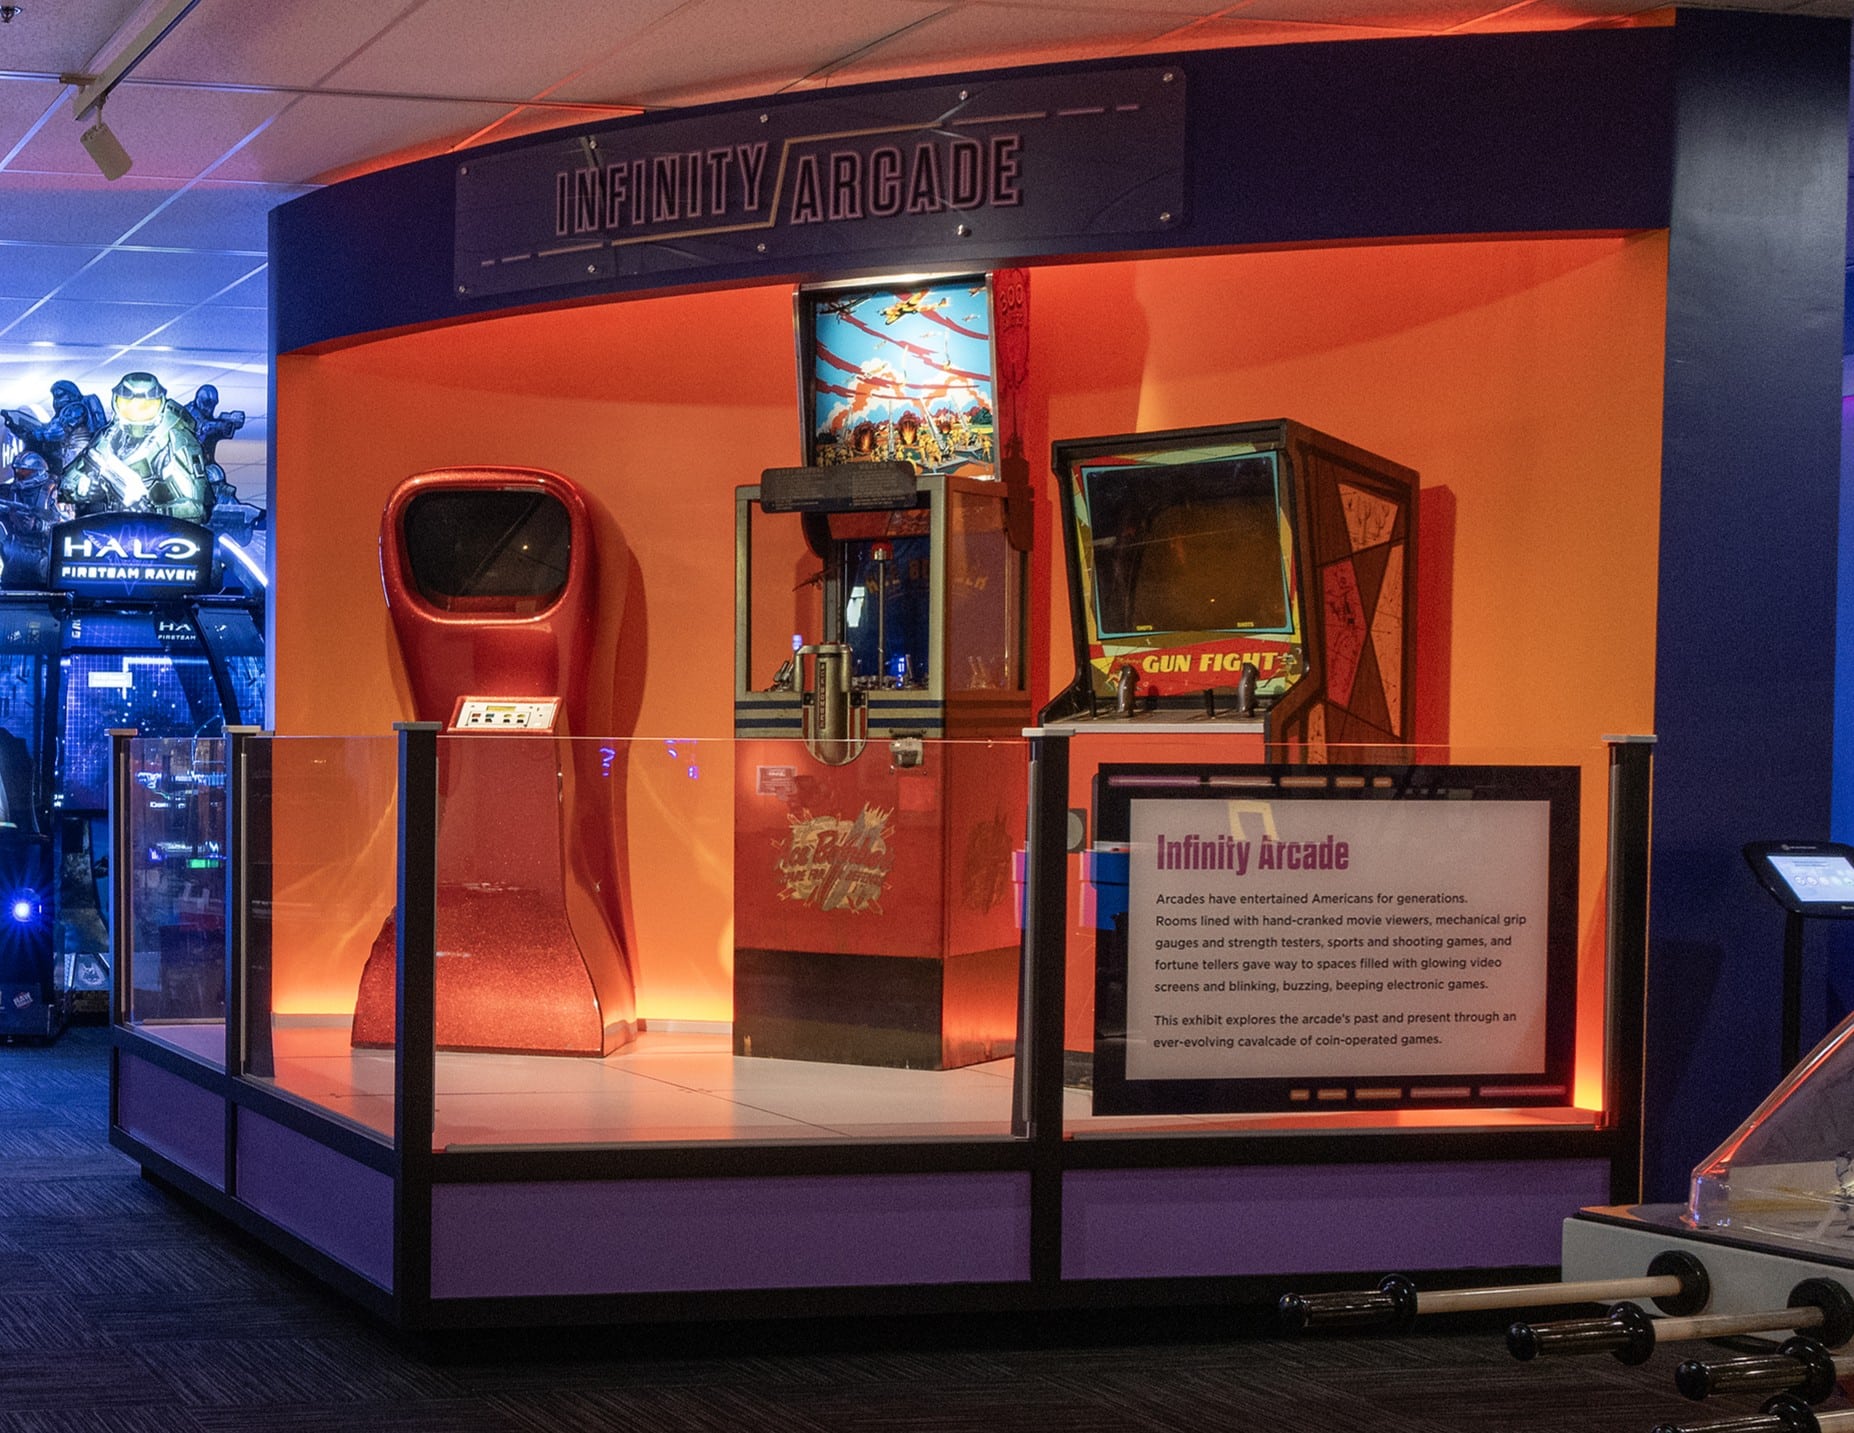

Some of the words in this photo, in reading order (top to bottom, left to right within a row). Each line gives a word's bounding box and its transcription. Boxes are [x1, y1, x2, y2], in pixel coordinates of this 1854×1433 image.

[554, 141, 769, 237] INFINITY
[790, 134, 1023, 226] ARCADE
[63, 536, 200, 559] HALO
[61, 566, 139, 579] FIRETEAM
[145, 568, 197, 581] RAVEN
[1142, 654, 1191, 673] GUN
[1200, 652, 1278, 672] FIGHT
[1157, 834, 1251, 876] Infinity
[1258, 834, 1349, 870] Arcade
[1156, 893, 1205, 905] Arcades
[1209, 893, 1237, 904] have
[1240, 893, 1308, 904] entertained
[1312, 893, 1373, 904] Americans
[1377, 893, 1393, 903] for
[1397, 892, 1467, 905] generations.
[1156, 916, 1197, 926] Rooms
[1201, 915, 1230, 926] lined
[1234, 915, 1259, 926] with
[1263, 915, 1343, 926] hand-cranked
[1347, 915, 1382, 925] movie
[1386, 915, 1432, 926] viewers,
[1436, 914, 1500, 925] mechanical
[1504, 914, 1526, 927] grip
[1155, 938, 1198, 950] gauges
[1202, 937, 1224, 948] and
[1228, 937, 1277, 950] strength
[1281, 938, 1324, 949] testers,
[1327, 937, 1364, 949] sports
[1368, 936, 1389, 947] and
[1393, 936, 1443, 948] shooting
[1447, 937, 1487, 948] games,
[1490, 936, 1512, 946] and
[1155, 959, 1199, 970] fortune
[1202, 959, 1239, 969] tellers
[1242, 960, 1270, 972] gave
[1275, 960, 1298, 971] way
[1301, 959, 1313, 969] to
[1317, 960, 1356, 971] spaces
[1360, 958, 1389, 968] filled
[1393, 957, 1417, 968] with
[1421, 957, 1466, 970] glowing
[1470, 957, 1502, 967] video
[1154, 983, 1199, 992] screens
[1203, 981, 1225, 992] and
[1229, 980, 1279, 993] blinking,
[1283, 980, 1332, 993] buzzing,
[1336, 980, 1383, 992] beeping
[1387, 979, 1444, 990] electronic
[1448, 981, 1488, 991] games.
[1154, 1015, 1178, 1025] This
[1182, 1014, 1222, 1025] exhibit
[1226, 1014, 1276, 1027] explores
[1280, 1014, 1298, 1024] the
[1302, 1013, 1350, 1024] arcade's
[1354, 1013, 1378, 1025] past
[1382, 1012, 1403, 1023] and
[1407, 1013, 1450, 1025] present
[1454, 1012, 1499, 1023] through
[1503, 1013, 1516, 1021] an
[1153, 1036, 1234, 1048] ever-evolving
[1238, 1036, 1296, 1046] cavalcade
[1300, 1035, 1313, 1046] of
[1316, 1035, 1397, 1047] coin-operated
[1401, 1036, 1442, 1047] games.
